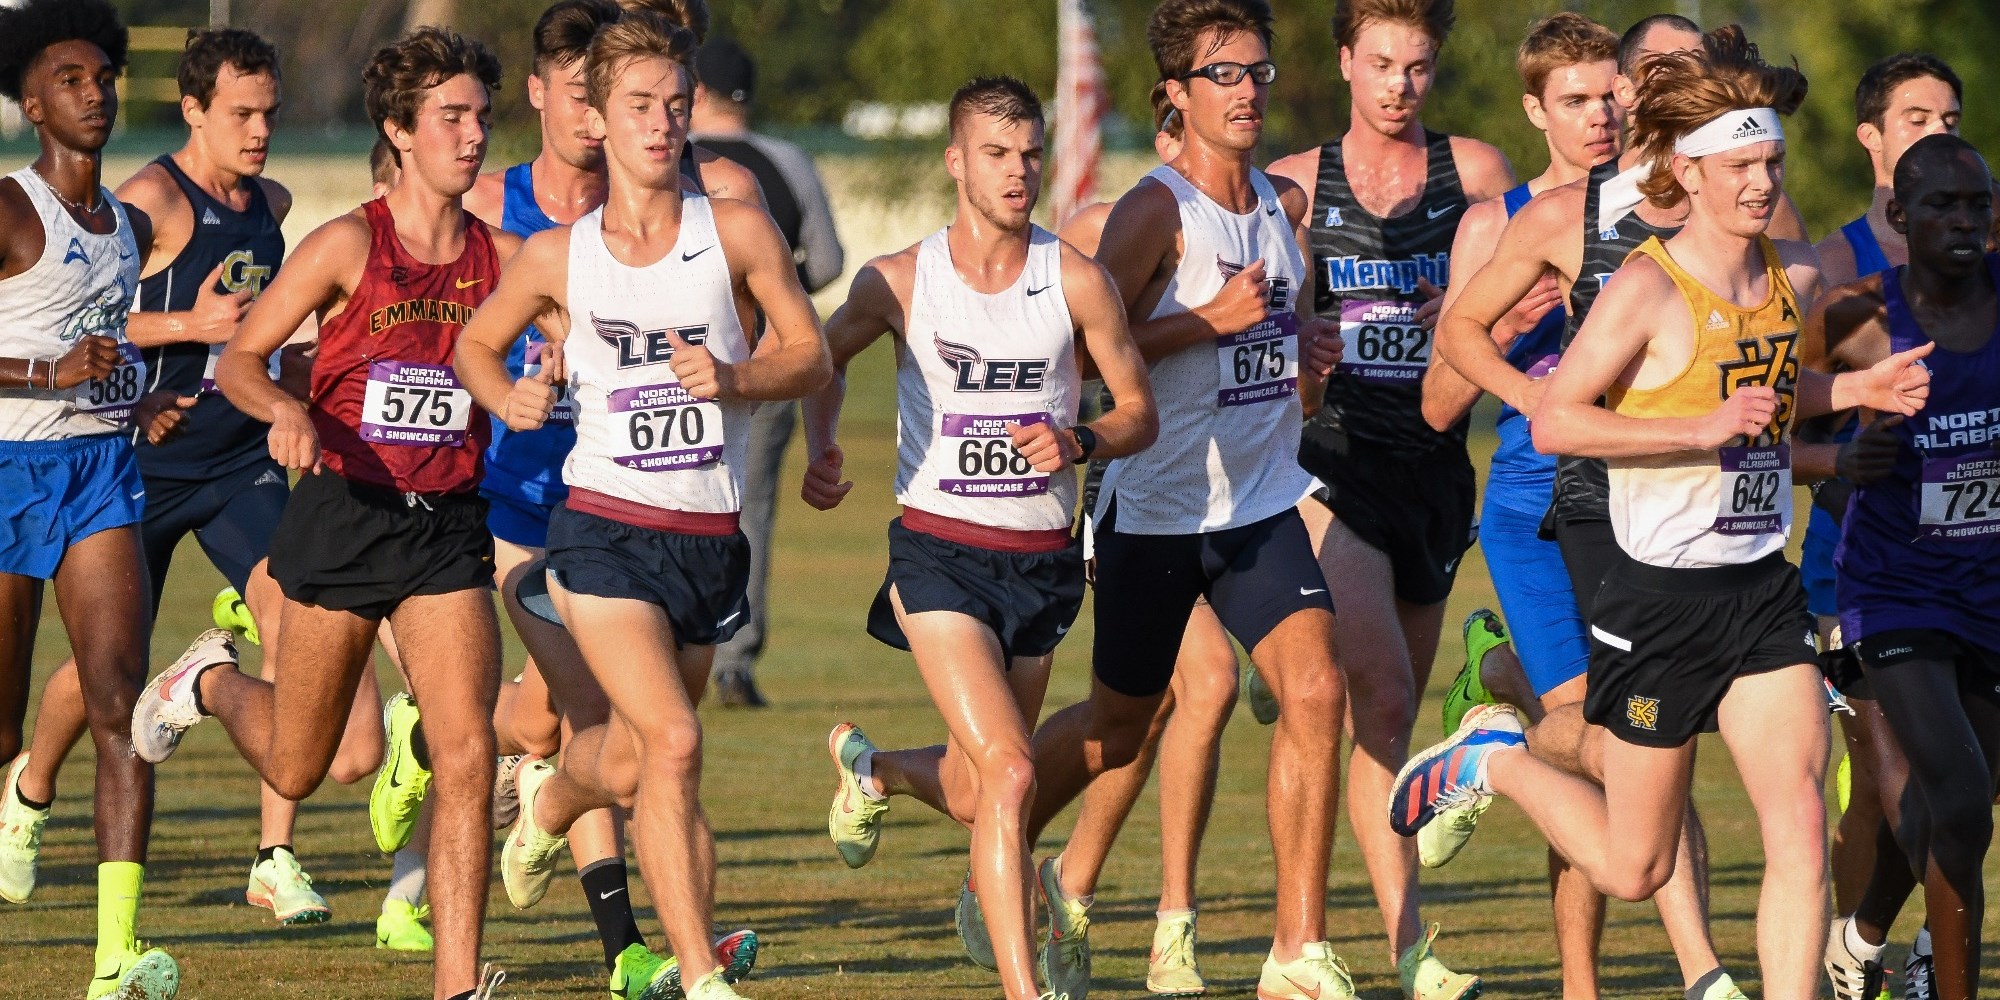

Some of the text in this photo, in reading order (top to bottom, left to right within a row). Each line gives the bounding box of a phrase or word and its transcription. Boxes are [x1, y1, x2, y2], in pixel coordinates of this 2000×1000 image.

[1732, 129, 1768, 139] adidas
[1322, 252, 1448, 294] Memphi
[369, 298, 477, 336] EMMANU
[1362, 312, 1415, 322] ALABA
[1243, 320, 1275, 333] ORTH
[1235, 327, 1282, 343] ALABAMA
[1357, 325, 1428, 362] 682
[1233, 339, 1285, 385] 675
[400, 367, 446, 378] NORTH
[954, 358, 1049, 392] LEE
[1363, 368, 1419, 379] SHOWCASE
[88, 365, 138, 406] 588
[389, 373, 453, 387] ALABAMA
[1238, 385, 1279, 401] SHOWCASE
[381, 386, 453, 427] 575
[1929, 407, 2000, 431] NORT
[628, 406, 704, 451] 670
[963, 427, 1010, 436] ALABA
[385, 430, 441, 443] SHOWCASE
[1914, 423, 2000, 449] ALABA
[640, 453, 699, 468] SHOWCASE
[958, 439, 1032, 476] 668
[1747, 451, 1776, 460] NORTH
[1738, 459, 1780, 469] ALABAMA
[1946, 468, 2000, 480] ALABAM
[965, 483, 1024, 493] SHOWCASE
[1732, 471, 1780, 514] 642
[1731, 520, 1768, 531] SHOWCASE
[1946, 524, 2000, 538] SHOWCASE
[1878, 646, 1913, 658] LIONS
